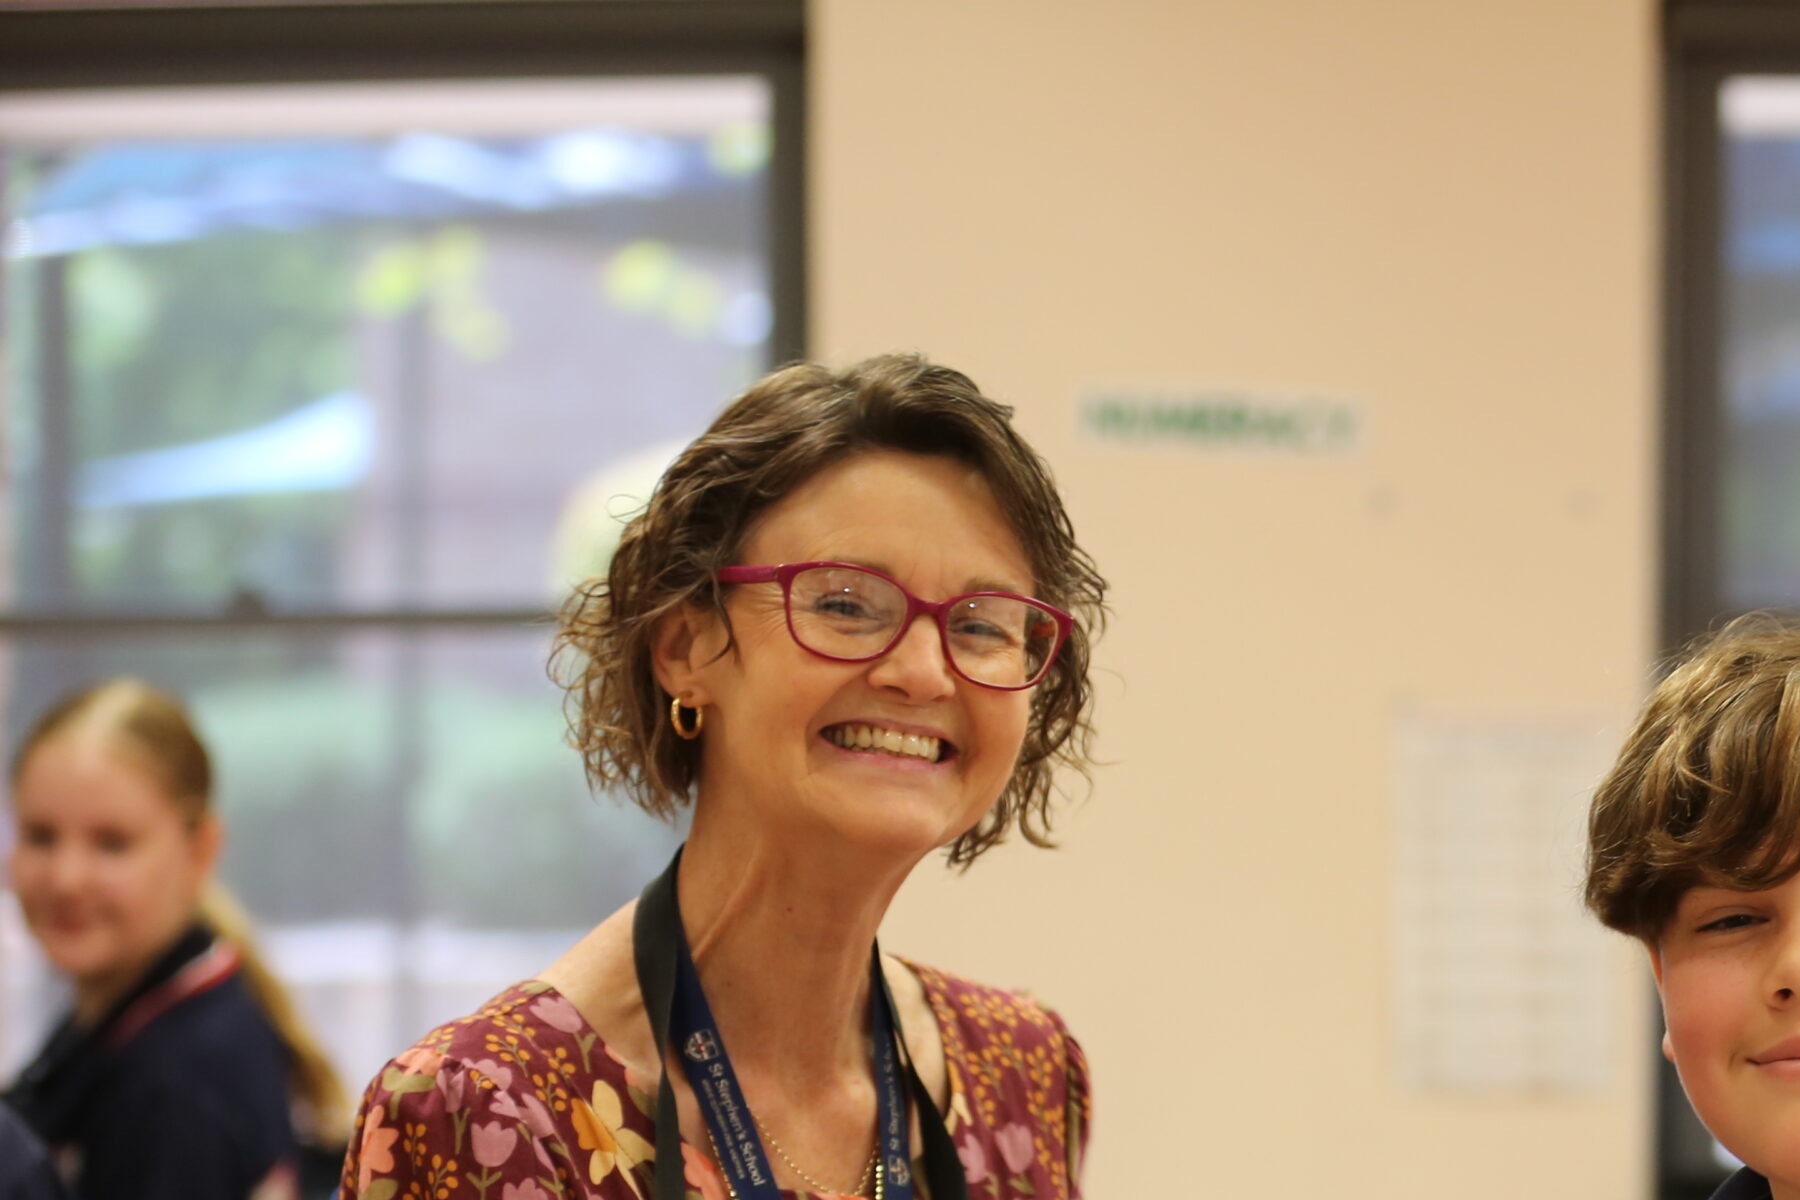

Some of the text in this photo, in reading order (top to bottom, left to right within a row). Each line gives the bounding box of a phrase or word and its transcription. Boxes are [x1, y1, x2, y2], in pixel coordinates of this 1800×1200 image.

[708, 1062, 723, 1078] St
[715, 1078, 748, 1141] Stephen's
[740, 1141, 766, 1187] School
